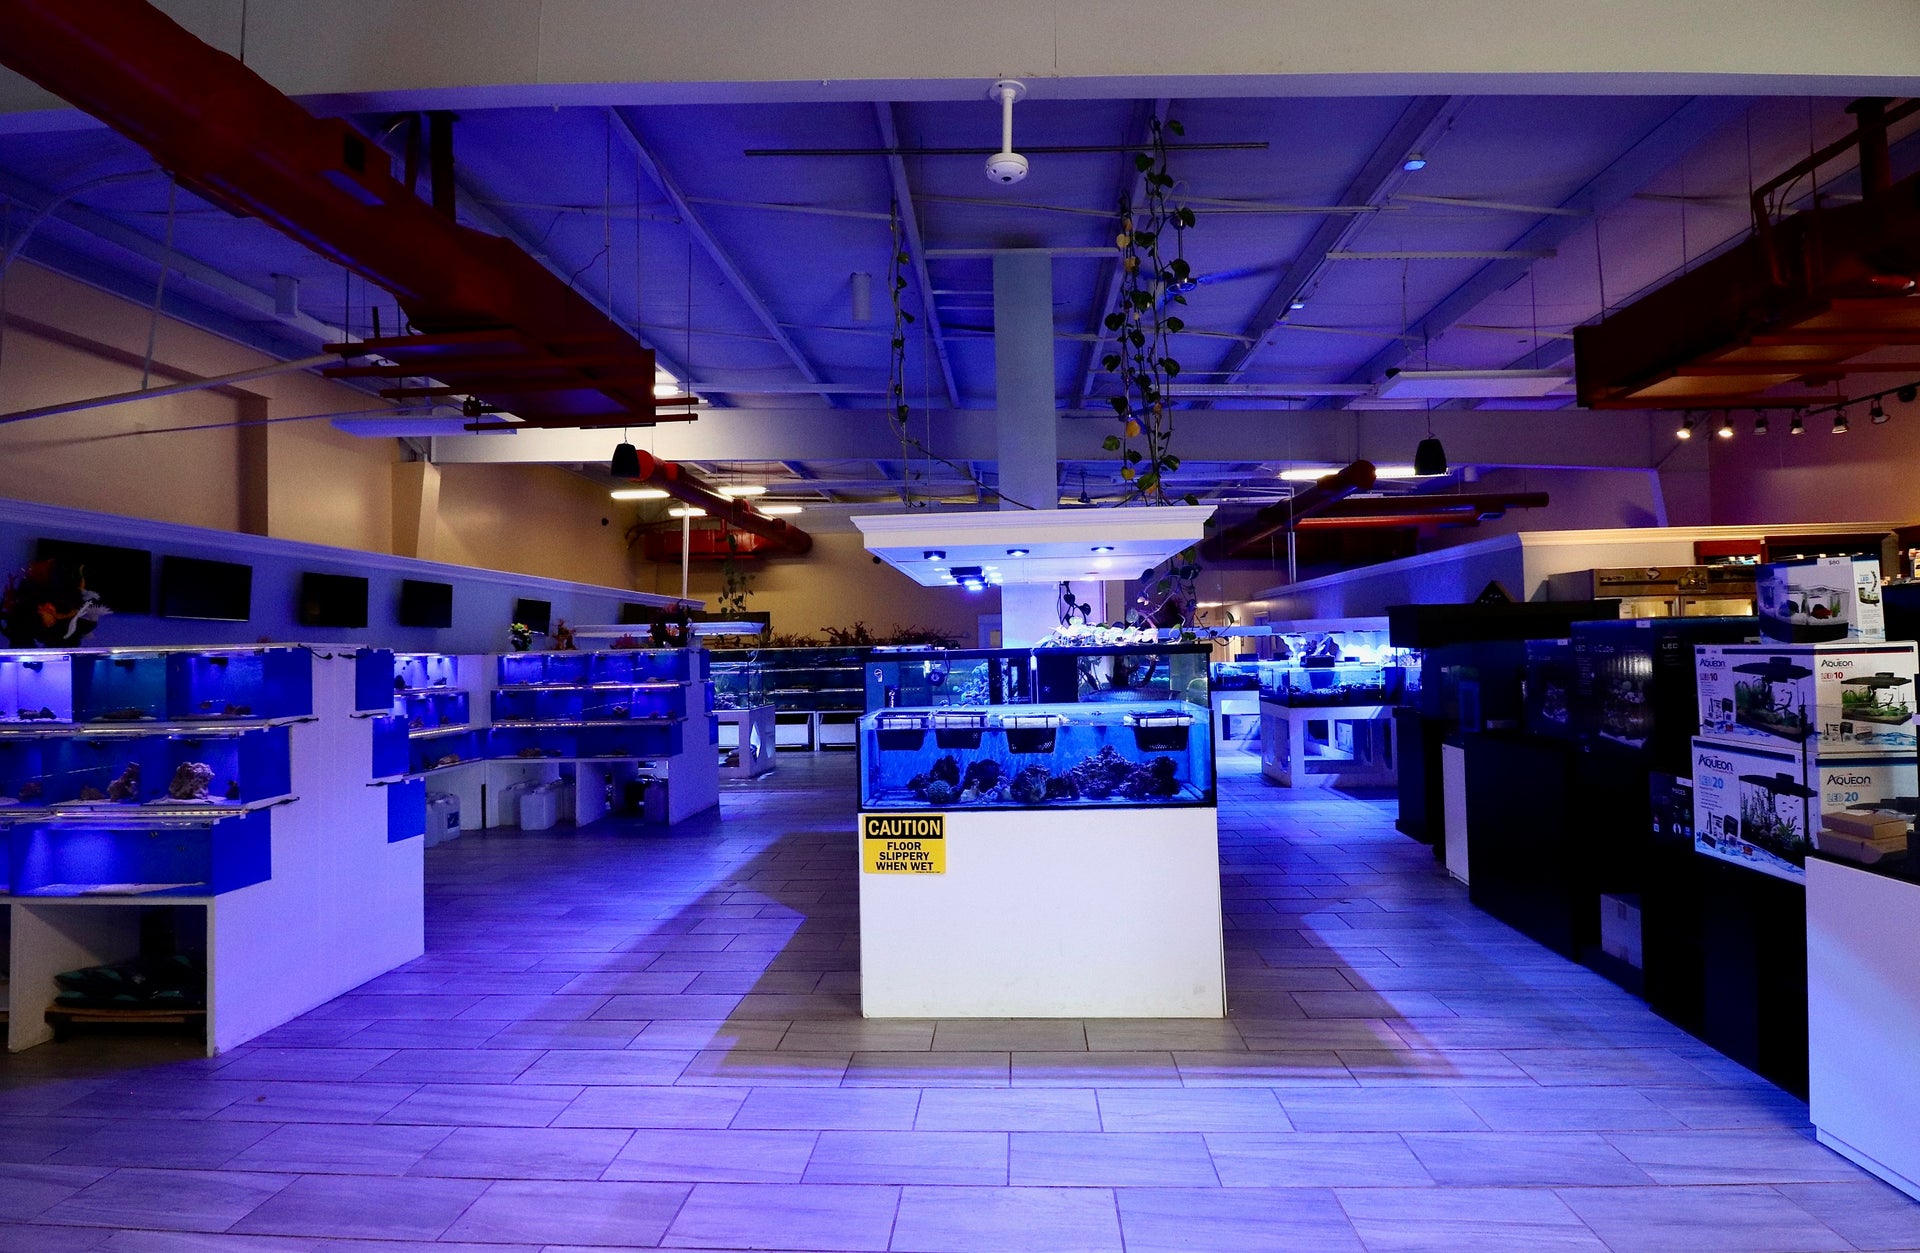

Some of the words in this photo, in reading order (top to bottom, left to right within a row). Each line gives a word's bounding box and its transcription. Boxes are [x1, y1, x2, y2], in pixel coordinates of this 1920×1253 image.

[1821, 659, 1854, 668] AQUEON
[1710, 672, 1718, 682] 10
[1834, 671, 1844, 680] 10
[1698, 754, 1734, 771] AQUEON
[1712, 776, 1724, 789] 20
[1827, 773, 1871, 786] AQUEON
[1844, 791, 1859, 802] 20
[868, 820, 941, 836] CAUTION
[887, 842, 921, 850] FLOOR
[879, 852, 929, 860] SLIPPERY
[876, 862, 907, 870] WHEN
[911, 862, 933, 870] WET
